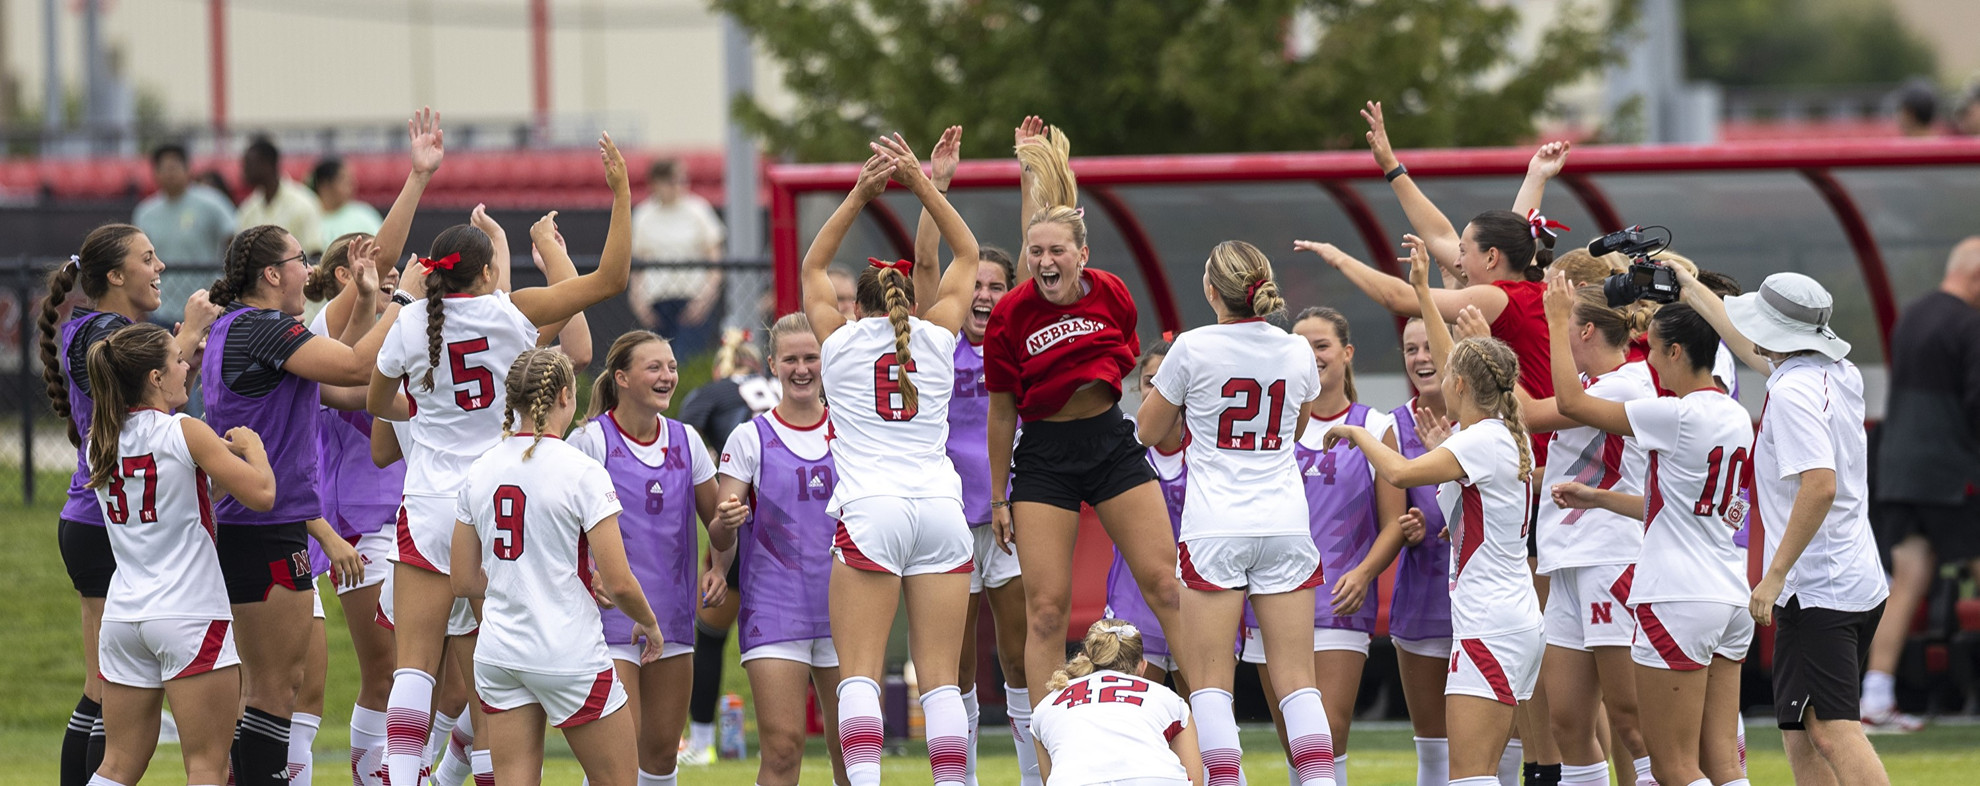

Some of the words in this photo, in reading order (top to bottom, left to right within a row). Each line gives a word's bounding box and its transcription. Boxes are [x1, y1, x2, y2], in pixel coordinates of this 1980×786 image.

[1028, 319, 1106, 353] NEBRASK
[447, 336, 496, 412] 5
[874, 352, 919, 422] 6
[1216, 377, 1287, 451] 21
[106, 452, 158, 525] 37
[645, 479, 664, 515] 8
[796, 465, 833, 501] 19
[1693, 446, 1748, 517] 10
[493, 485, 526, 561] 9
[292, 549, 311, 577] N
[1591, 602, 1612, 624] N
[1052, 675, 1149, 709] 42
